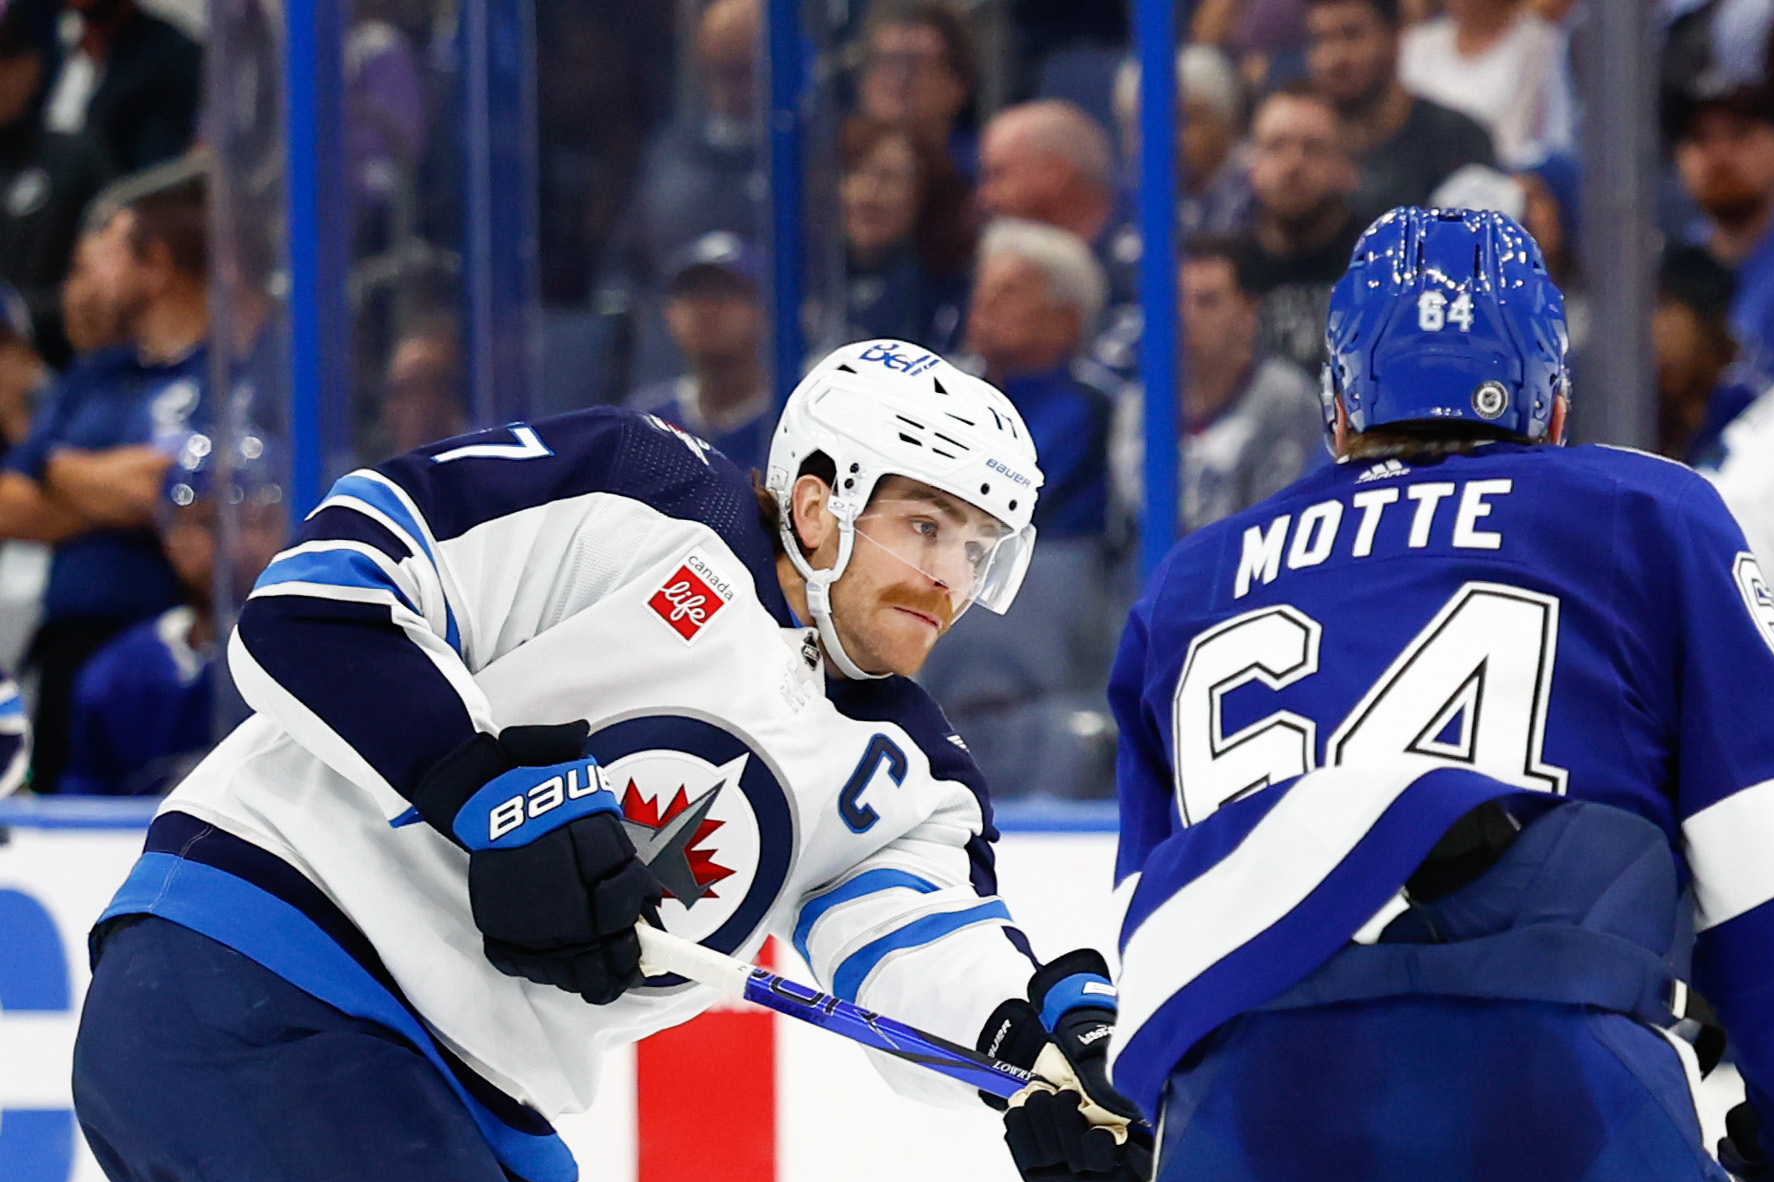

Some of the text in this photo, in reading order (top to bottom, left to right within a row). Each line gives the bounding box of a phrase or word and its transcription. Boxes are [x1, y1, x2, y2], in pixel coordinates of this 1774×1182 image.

[1418, 290, 1474, 332] 64
[859, 344, 941, 377] Bell
[1234, 479, 1512, 599] MOTTE
[687, 555, 734, 601] canada
[660, 581, 706, 628] life
[1174, 581, 1568, 828] 64
[838, 733, 908, 834] C
[992, 1060, 1036, 1082] LOWRY
